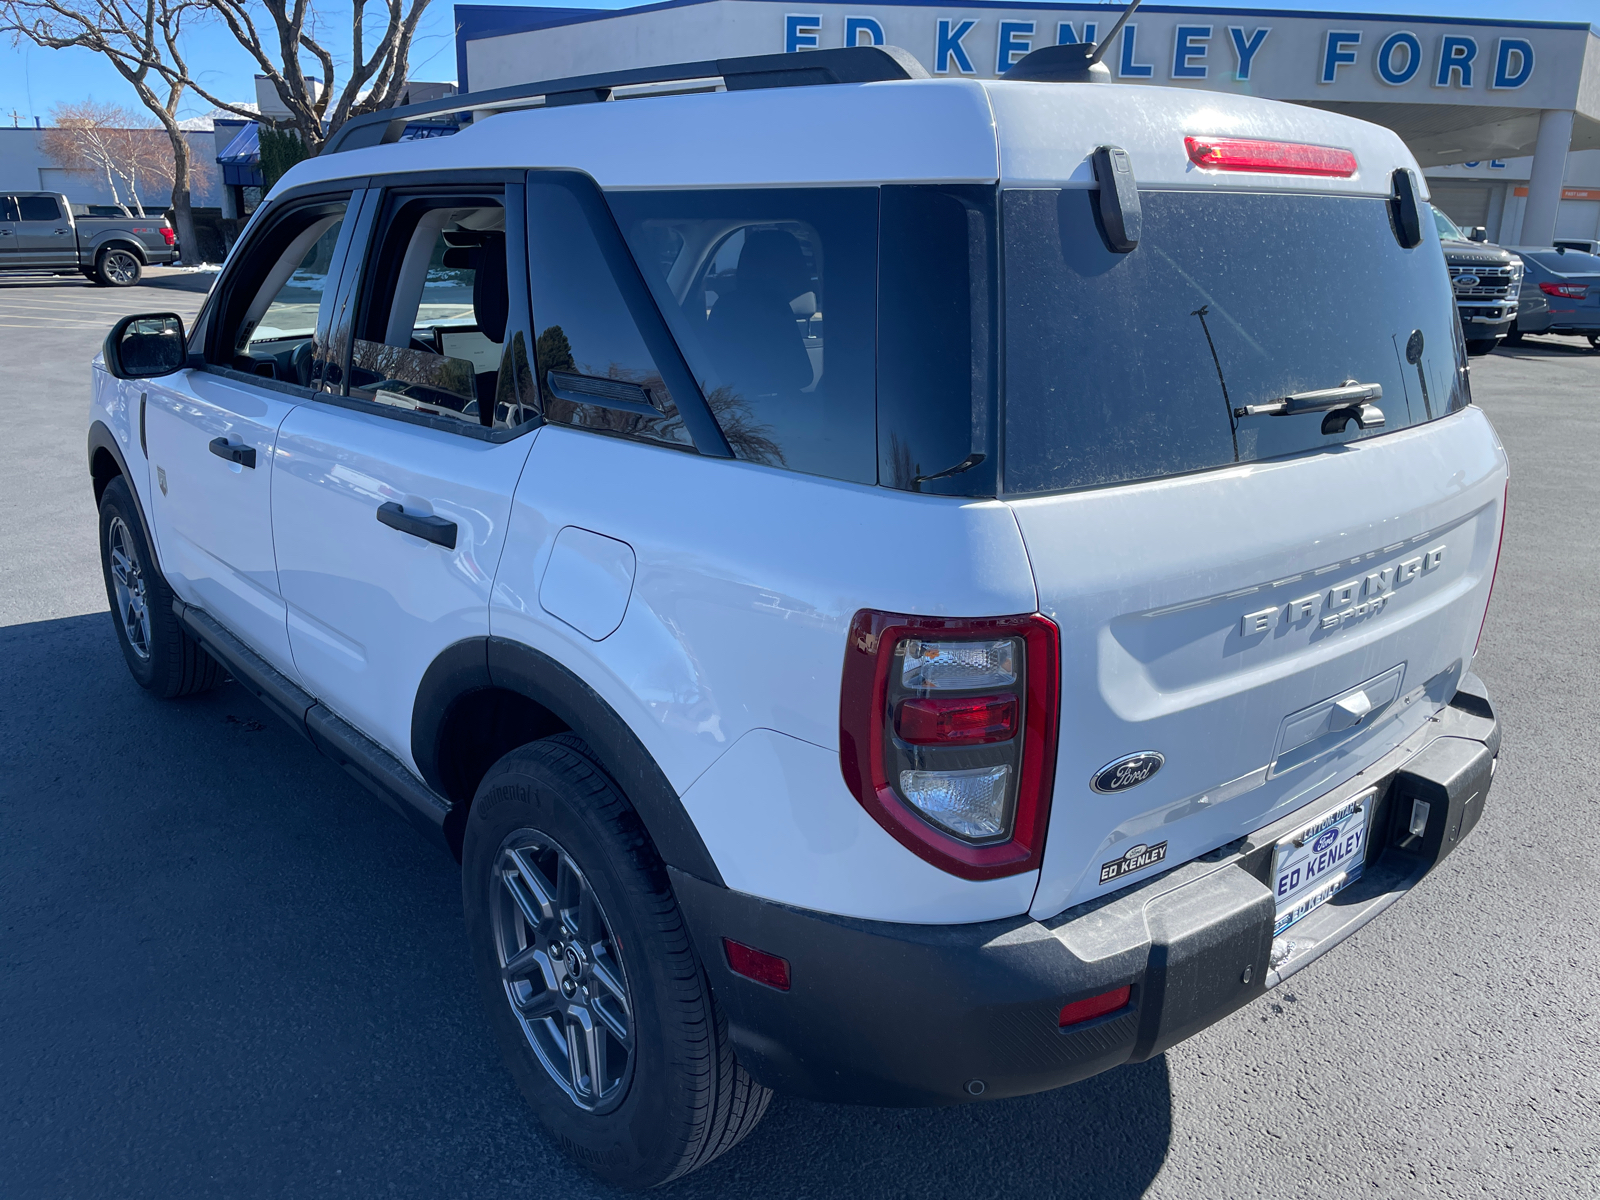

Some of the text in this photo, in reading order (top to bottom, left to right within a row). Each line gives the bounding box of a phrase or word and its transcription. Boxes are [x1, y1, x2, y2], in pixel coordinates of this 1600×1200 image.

[784, 13, 886, 53] ED
[1321, 29, 1536, 90] FORD
[1240, 544, 1446, 637] BRONCO
[1320, 591, 1396, 630] SPORT
[1110, 760, 1153, 788] Ford
[477, 782, 532, 820] Continental
[1317, 832, 1335, 851] Ford
[1101, 845, 1167, 880] ED KENLEY
[1278, 828, 1364, 896] ED KENLEY
[1292, 901, 1306, 919] ED
